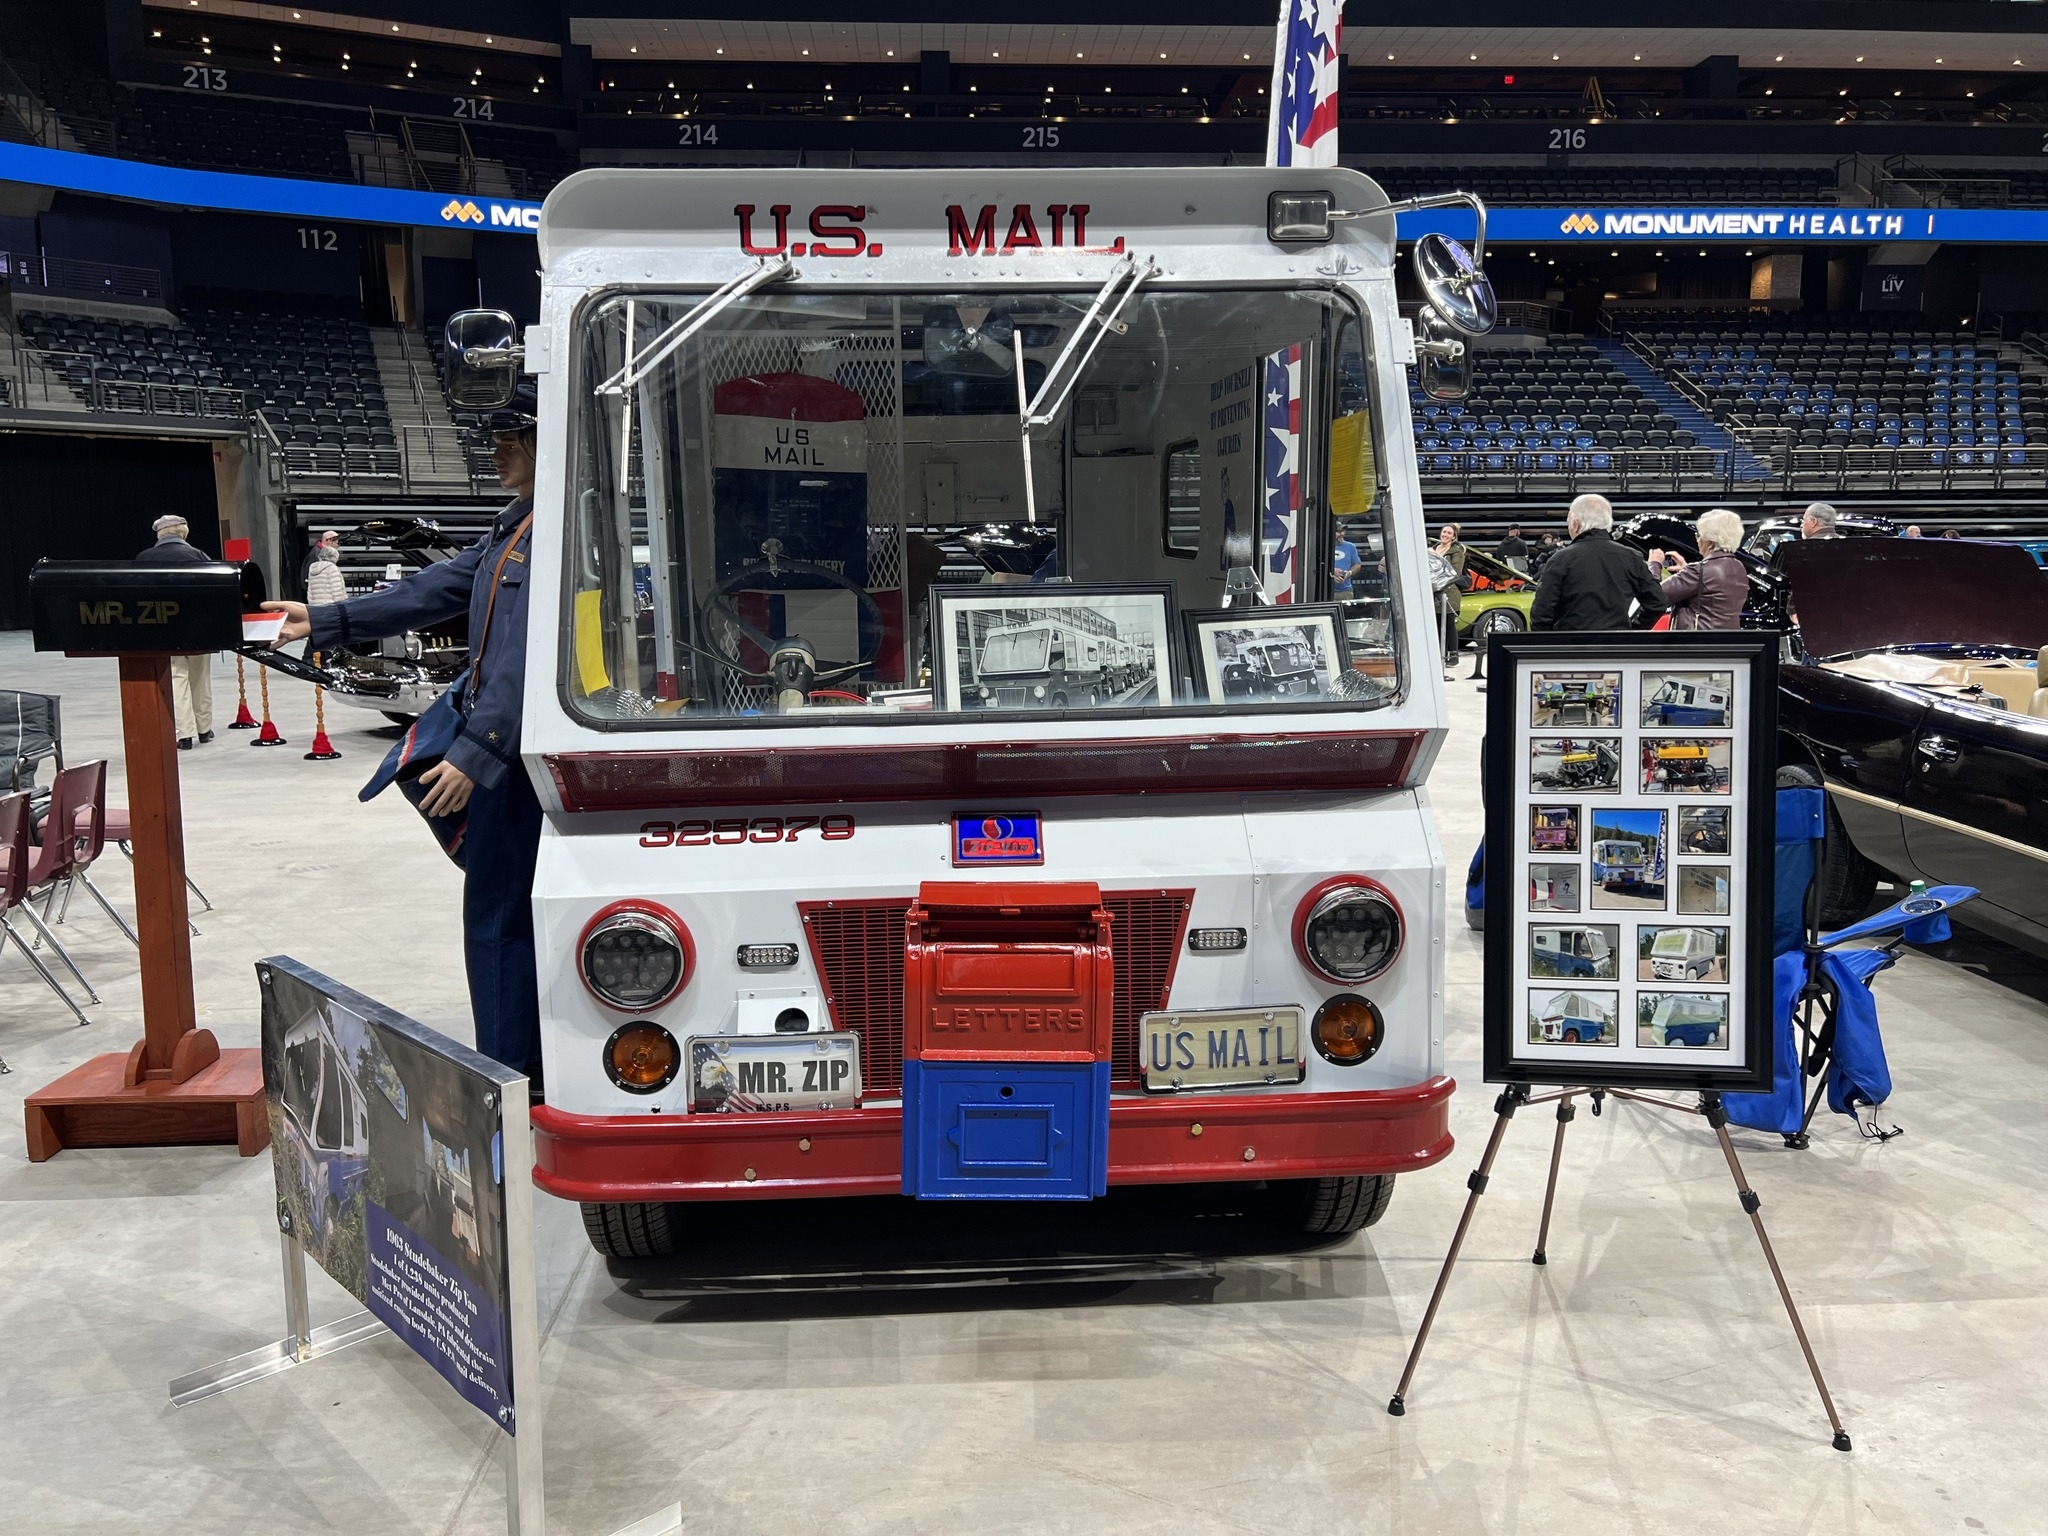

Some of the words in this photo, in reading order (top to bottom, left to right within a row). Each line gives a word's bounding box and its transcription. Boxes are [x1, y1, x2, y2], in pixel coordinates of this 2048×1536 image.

[183, 66, 227, 91] 213
[453, 97, 494, 121] 214
[679, 124, 719, 145] 214
[1022, 126, 1060, 147] 215
[1549, 128, 1586, 149] 216
[734, 204, 883, 258] U.S.
[945, 204, 1126, 257] MAIL
[1604, 215, 1784, 234] MONUMENT
[1788, 215, 1903, 235] HEALTH
[297, 228, 338, 251] 112
[1881, 280, 1905, 292] LIV
[776, 427, 810, 446] US
[764, 446, 825, 466] MAIL
[79, 601, 133, 625] MR.
[136, 601, 180, 624] ZIP
[639, 815, 855, 848] 325379
[931, 1007, 1086, 1032] LETTERS
[1151, 1031, 1195, 1071] US
[1208, 1025, 1296, 1069] MAIL
[738, 1061, 794, 1094] MR.
[802, 1060, 849, 1092] ZIP
[387, 1228, 403, 1252] 1963
[404, 1242, 448, 1287] Studebaker
[449, 1276, 463, 1304] Zip
[463, 1289, 478, 1316] Van
[397, 1259, 405, 1271] of
[423, 1280, 440, 1300] units
[440, 1295, 471, 1328] produced.
[370, 1252, 401, 1283] Studebaker
[401, 1279, 425, 1304] provided
[425, 1297, 436, 1312] the
[436, 1306, 454, 1329] chassis
[454, 1325, 464, 1340] and
[464, 1333, 497, 1368] drivetrain.
[381, 1275, 392, 1292] Met
[402, 1296, 409, 1307] of
[437, 1321, 446, 1338] PA
[446, 1330, 470, 1365] fabricated
[471, 1359, 484, 1374] the
[371, 1285, 393, 1308] unitized
[393, 1303, 410, 1325] custom
[411, 1316, 426, 1338] body
[427, 1328, 436, 1344] for
[455, 1361, 468, 1379] mail
[468, 1371, 499, 1400] delivery.
